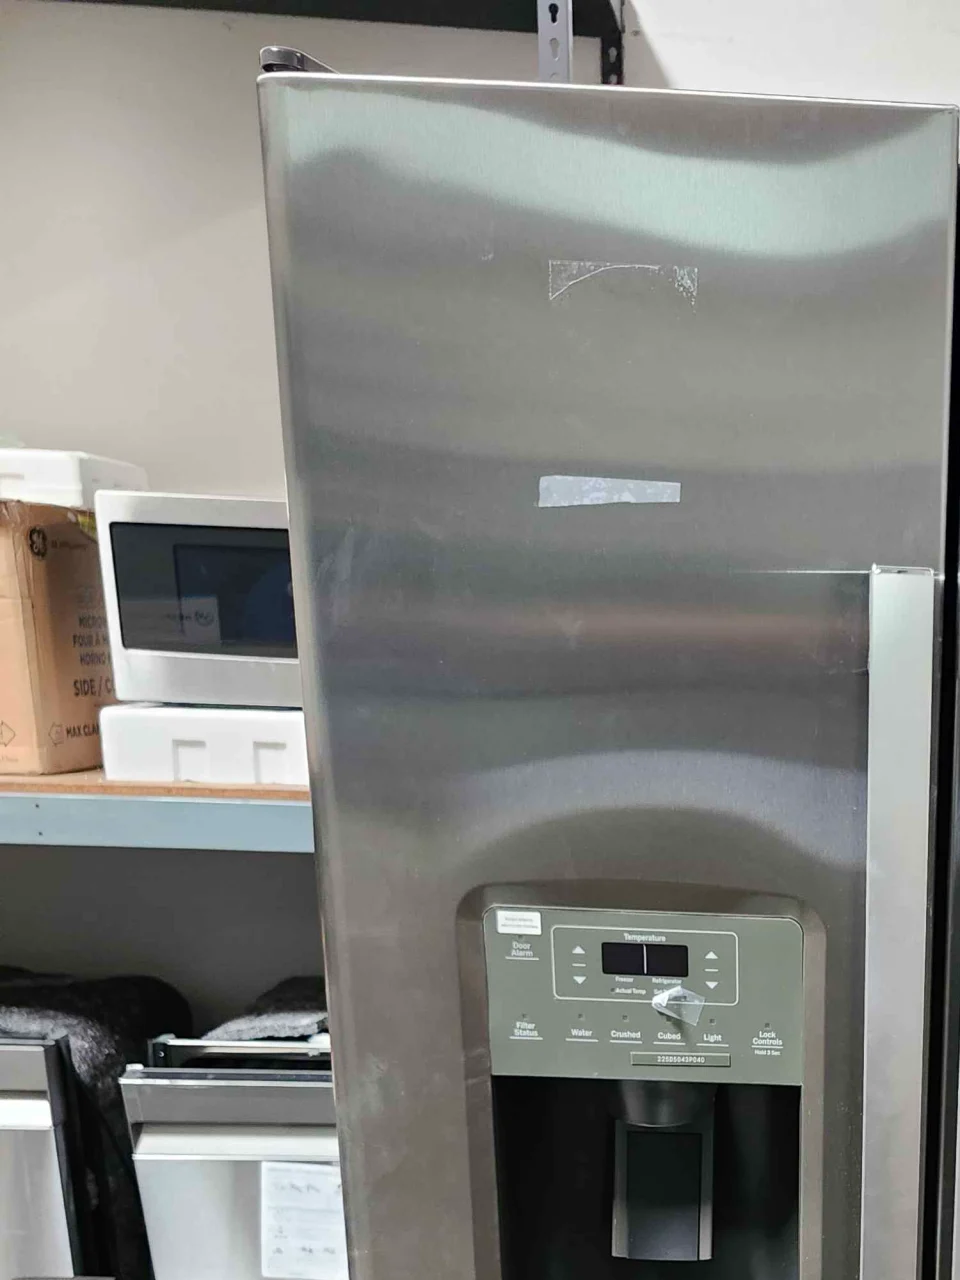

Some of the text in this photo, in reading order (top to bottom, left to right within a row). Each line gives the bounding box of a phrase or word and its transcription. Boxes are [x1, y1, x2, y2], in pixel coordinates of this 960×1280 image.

[73, 679, 96, 698] SIDE
[66, 726, 81, 739] MAX
[623, 933, 666, 943] Temperature
[512, 941, 531, 950] Door
[511, 949, 534, 957] Alarm
[633, 988, 647, 996] Temp
[516, 1021, 536, 1030] Filter
[514, 1028, 538, 1037] Status
[571, 1028, 593, 1037] Water
[610, 1030, 641, 1039] Crushed
[657, 1031, 682, 1040] Cubed
[703, 1033, 722, 1043] Light
[752, 1037, 783, 1046] Controls
